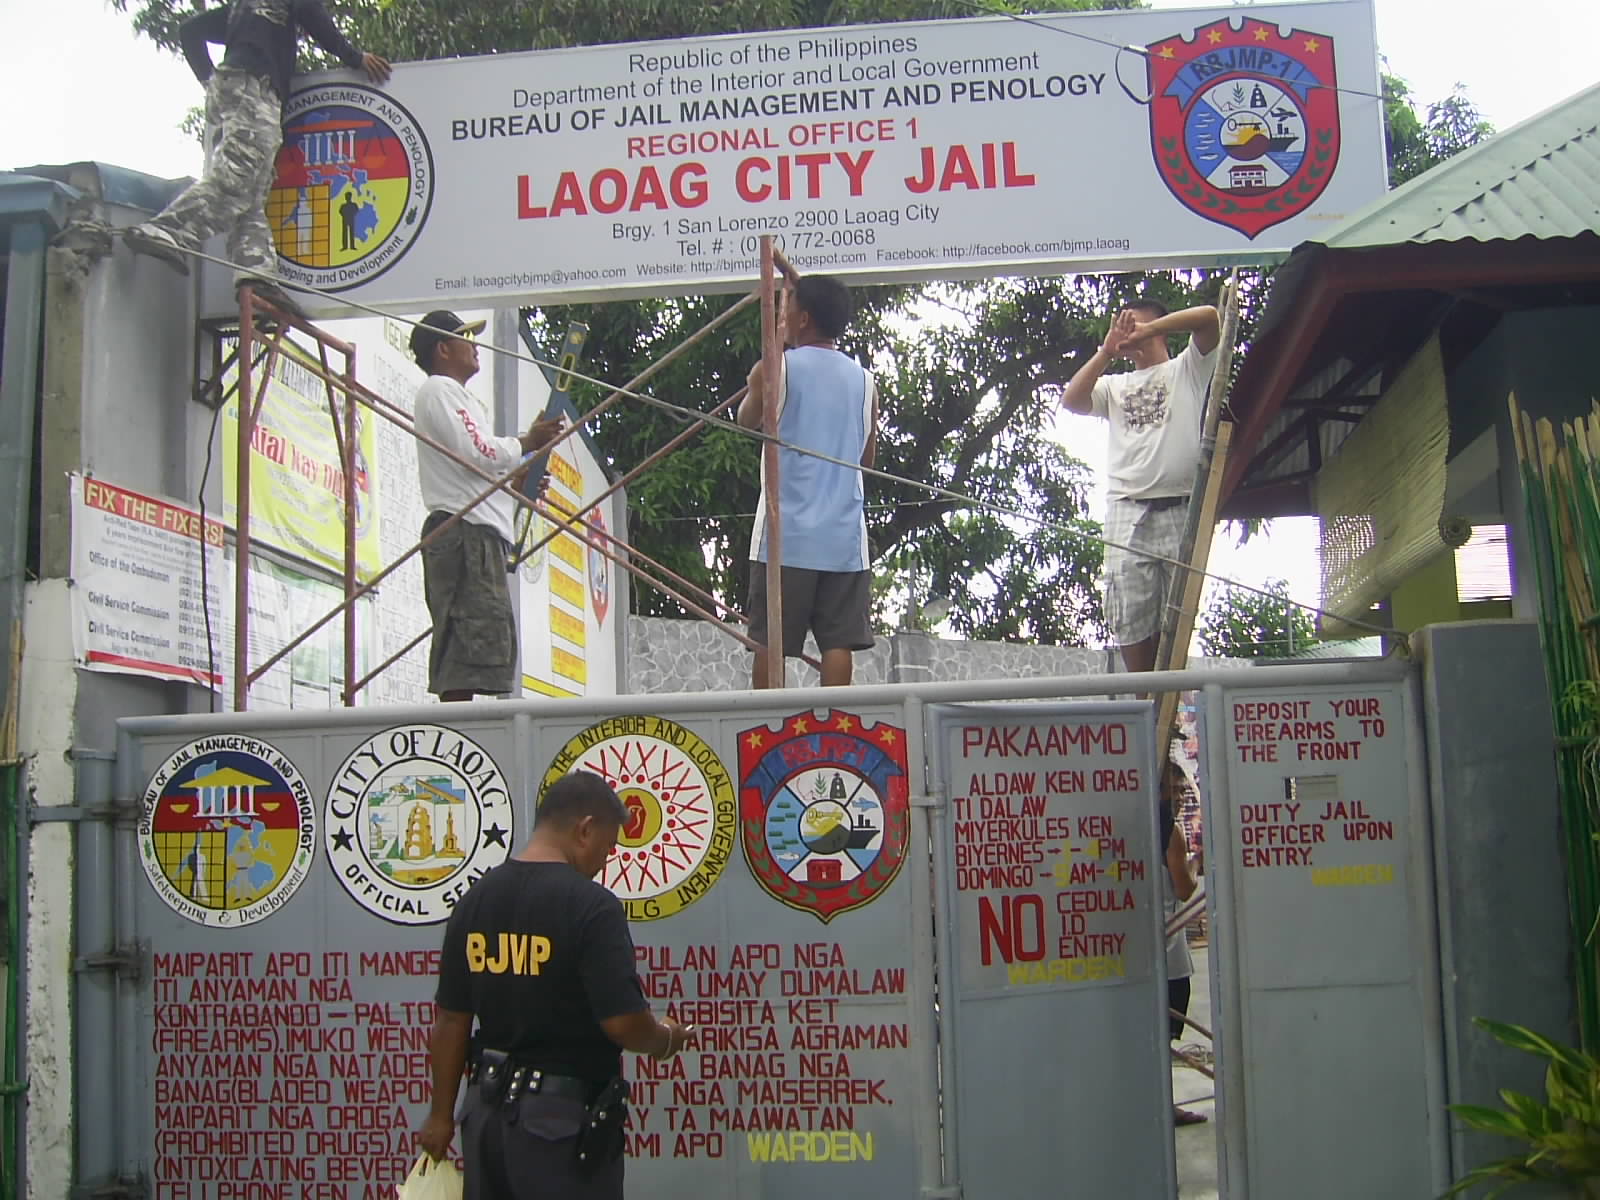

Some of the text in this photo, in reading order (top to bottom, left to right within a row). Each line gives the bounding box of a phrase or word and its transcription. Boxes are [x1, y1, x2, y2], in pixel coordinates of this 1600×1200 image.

[628, 36, 918, 75] Republic of the Philippines
[513, 51, 1040, 112] Department of the Interior and Local Government
[451, 72, 1106, 141] BUREAU OF JAIL MANAGEMENT AND PENOLOGY
[376, 103, 403, 127] AND
[401, 125, 426, 200] PENOLOGY
[627, 117, 919, 159] REGIONAL OFFICE 1
[516, 141, 1036, 220] LAOAG CITY JAIL
[612, 204, 940, 243] Brgy. 1 San Lorenzo 2900 Laoag City
[676, 239, 706, 257] Tel.
[711, 240, 724, 255] #
[792, 229, 875, 250] 772-0068
[316, 235, 404, 284] and Development
[435, 277, 470, 291] Email:
[473, 266, 626, 290] laoagcitybjmp@yahoo.com
[636, 261, 686, 277] Website:
[877, 248, 939, 263] Facebook:
[943, 237, 1130, 257] http://facebook.com/bjmp.laoag
[85, 482, 116, 512] FIX
[121, 494, 160, 525] THE
[1233, 698, 1380, 721] DEPOSIT YOUR
[962, 723, 1127, 758] PAKAAMMO
[1234, 719, 1384, 742] FIREARMS TO
[1238, 741, 1360, 762] THE FRONT
[330, 730, 508, 820] CITY OF LAOAG
[969, 768, 1139, 797] ALDAW KEN ORAS
[139, 736, 314, 853] BUREAU OF JAIL MANAGEMENT AND PENOLOGY
[952, 796, 1047, 821] TI DALAW
[551, 717, 735, 907] THE INTERIOR AND LOCAL GOVERNMENT
[1240, 801, 1370, 823] DUTY JAIL
[954, 816, 1112, 843] MIYERKULES KEN
[1241, 821, 1393, 845] OFFICER UPON
[955, 841, 1044, 867] BIYERNES
[1243, 847, 1313, 867] ENTRY.
[345, 863, 429, 916] OFFICIAL
[956, 866, 1033, 891] DOMINGO
[149, 863, 304, 925] Safekeeping & Development
[1056, 888, 1135, 914] CEDULA
[978, 894, 1046, 966] NO
[153, 952, 253, 977] MAIPARIT
[265, 952, 311, 977] APO
[323, 952, 349, 976] ITI
[730, 944, 780, 970] APO
[794, 943, 844, 969] NGA
[1059, 933, 1125, 959] ENTRY
[153, 979, 178, 1002] ITI
[189, 978, 298, 1002] ANYAMAN
[309, 978, 353, 1002] NGA
[697, 971, 767, 999] UMAY
[781, 968, 905, 997] DUMALAW
[1008, 956, 1125, 985] WARDEN
[153, 1003, 321, 1028] KONTRABANDO
[788, 999, 839, 1024] KET
[791, 1024, 908, 1050] AGRAMAN
[156, 1054, 262, 1077] ANYAMAN
[273, 1054, 319, 1077] NGA
[636, 1053, 685, 1080] NGA
[700, 1053, 786, 1080] BANAG
[800, 1053, 851, 1079] NGA
[673, 1081, 724, 1106] NGA
[738, 1079, 893, 1106] MAISERREK.
[155, 1105, 854, 1132] MAIPARIT NGA DROGA TA MAAWATAN
[154, 1130, 295, 1156] (PROHIBITED
[673, 1133, 723, 1158] APO
[748, 1131, 874, 1163] WARDEN
[153, 1156, 316, 1181] (INTOXICATING
